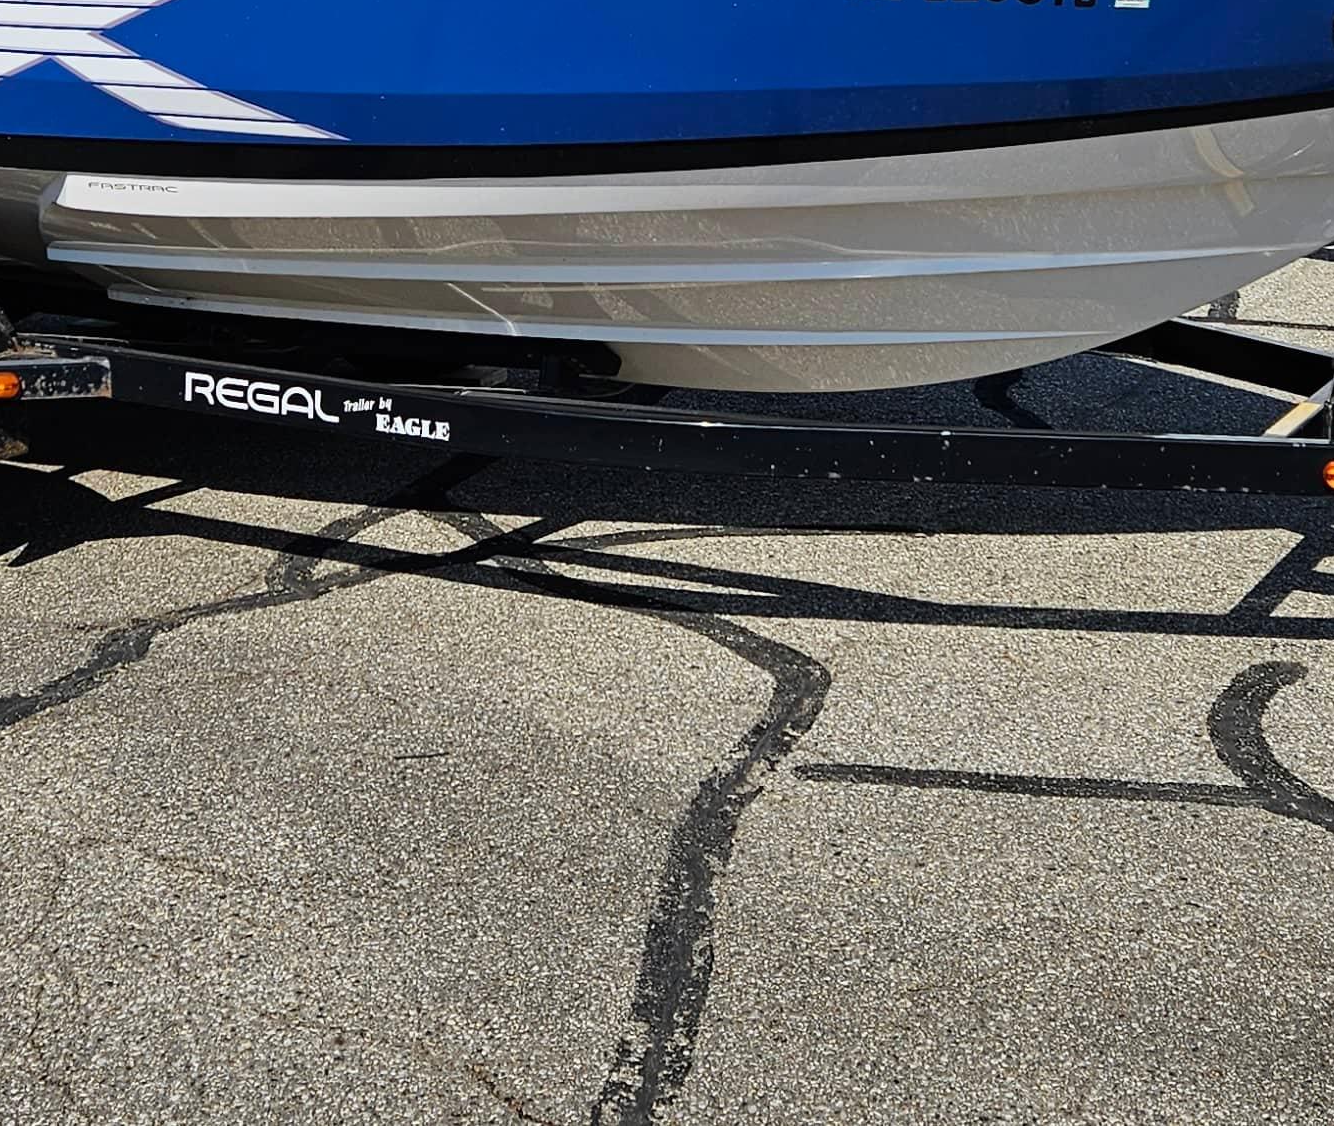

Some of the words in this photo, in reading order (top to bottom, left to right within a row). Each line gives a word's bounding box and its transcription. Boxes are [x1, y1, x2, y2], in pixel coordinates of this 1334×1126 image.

[88, 181, 179, 193] FASTRAC
[184, 371, 340, 424] REGAL
[378, 396, 393, 412] by
[375, 413, 451, 442] EAGLE
